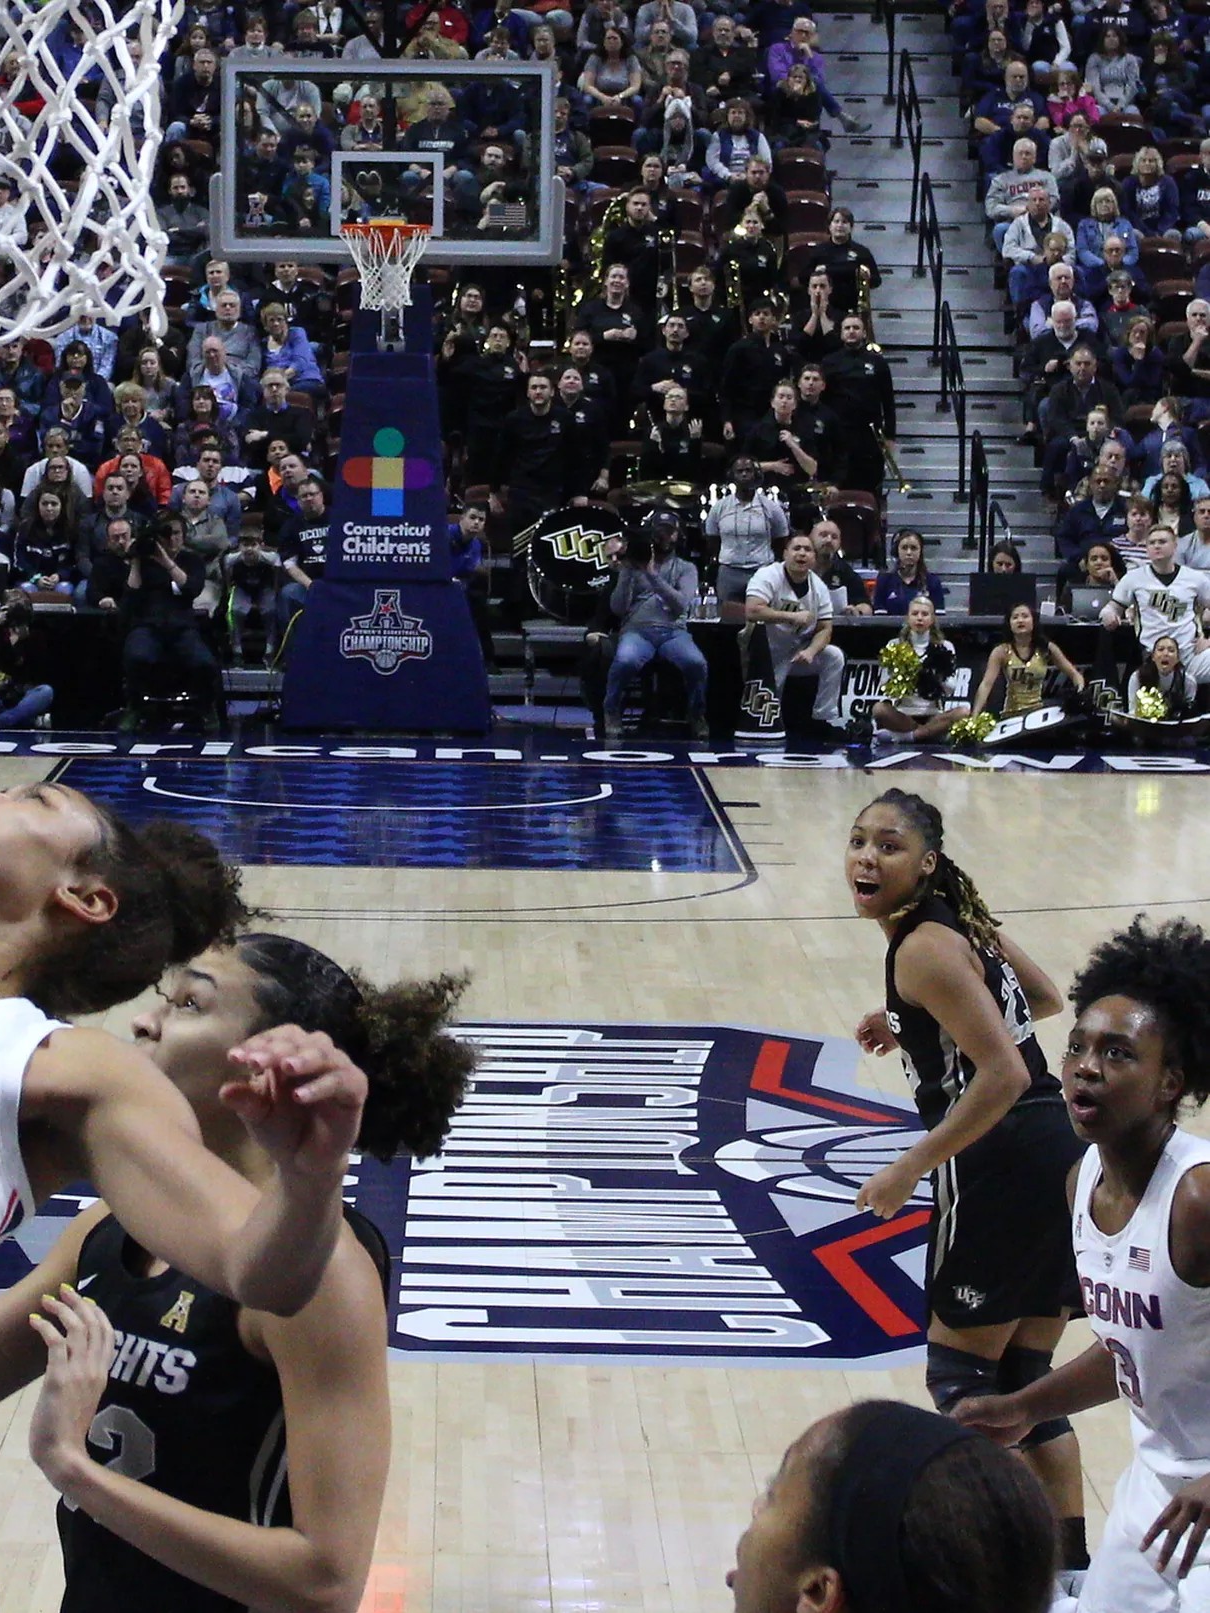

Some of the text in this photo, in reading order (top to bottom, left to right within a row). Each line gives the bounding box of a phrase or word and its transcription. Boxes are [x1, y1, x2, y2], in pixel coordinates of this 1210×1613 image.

[343, 521, 431, 537] Connecticut
[343, 536, 430, 555] Children's
[344, 635, 429, 652] CHAMPIONSHIP
[741, 680, 781, 727] UCF
[983, 706, 1065, 742] GO
[953, 1285, 986, 1309] UCF
[1080, 1276, 1164, 1330] CONN
